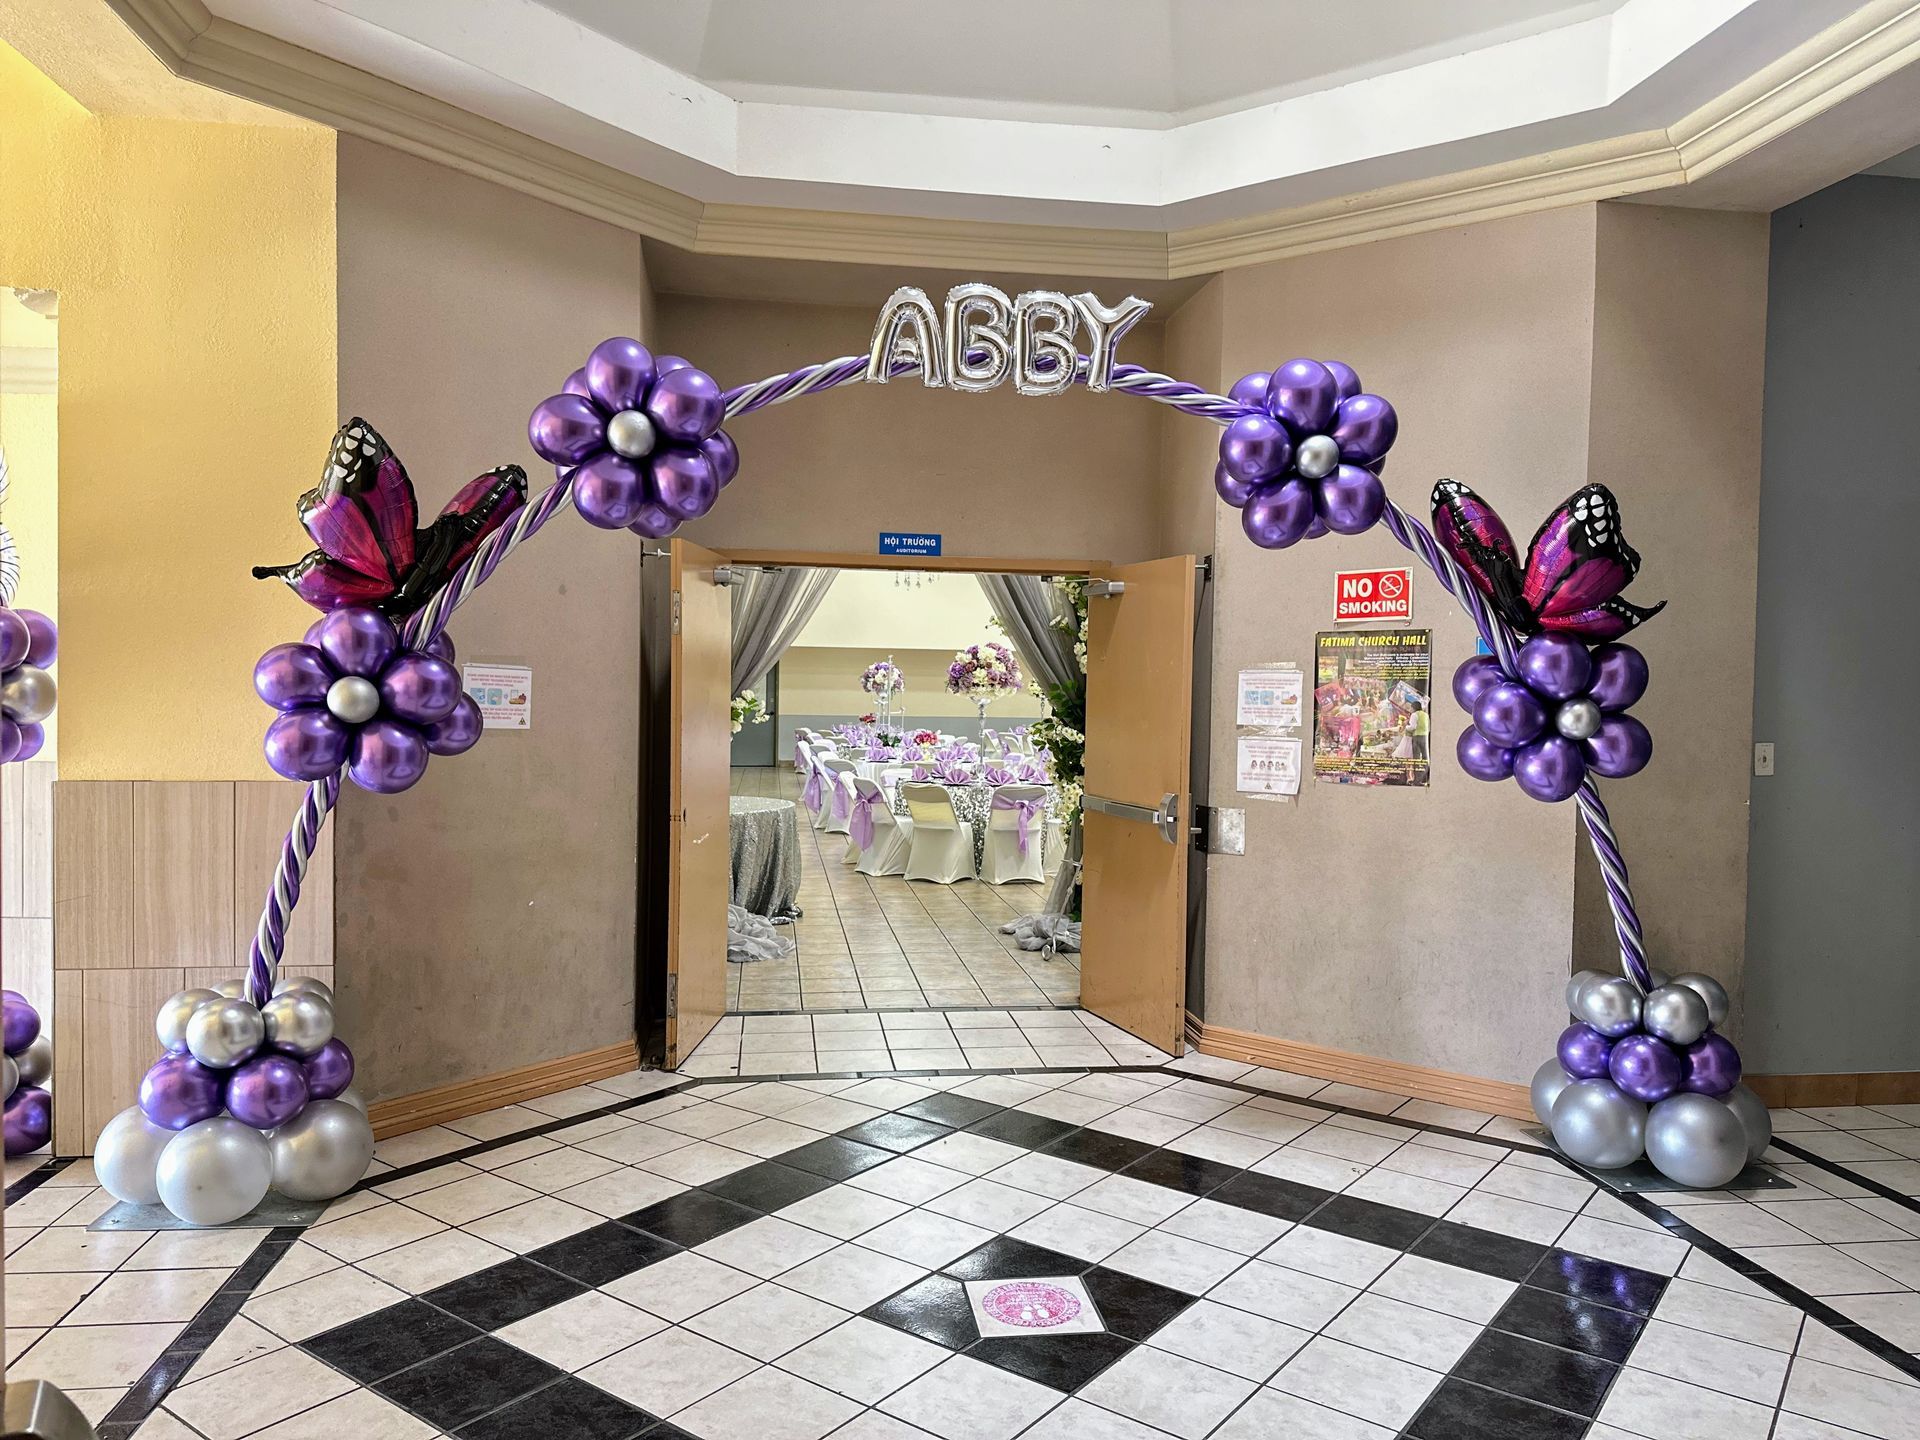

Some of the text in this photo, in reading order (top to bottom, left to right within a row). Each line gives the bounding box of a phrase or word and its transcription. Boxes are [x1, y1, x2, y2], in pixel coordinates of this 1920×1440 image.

[865, 282, 1154, 396] ABBY
[884, 536, 899, 547] HỘI
[1343, 577, 1373, 599] NO
[1339, 599, 1407, 614] SMOKING
[1320, 635, 1427, 647] FATIMA CHURCH HALL
